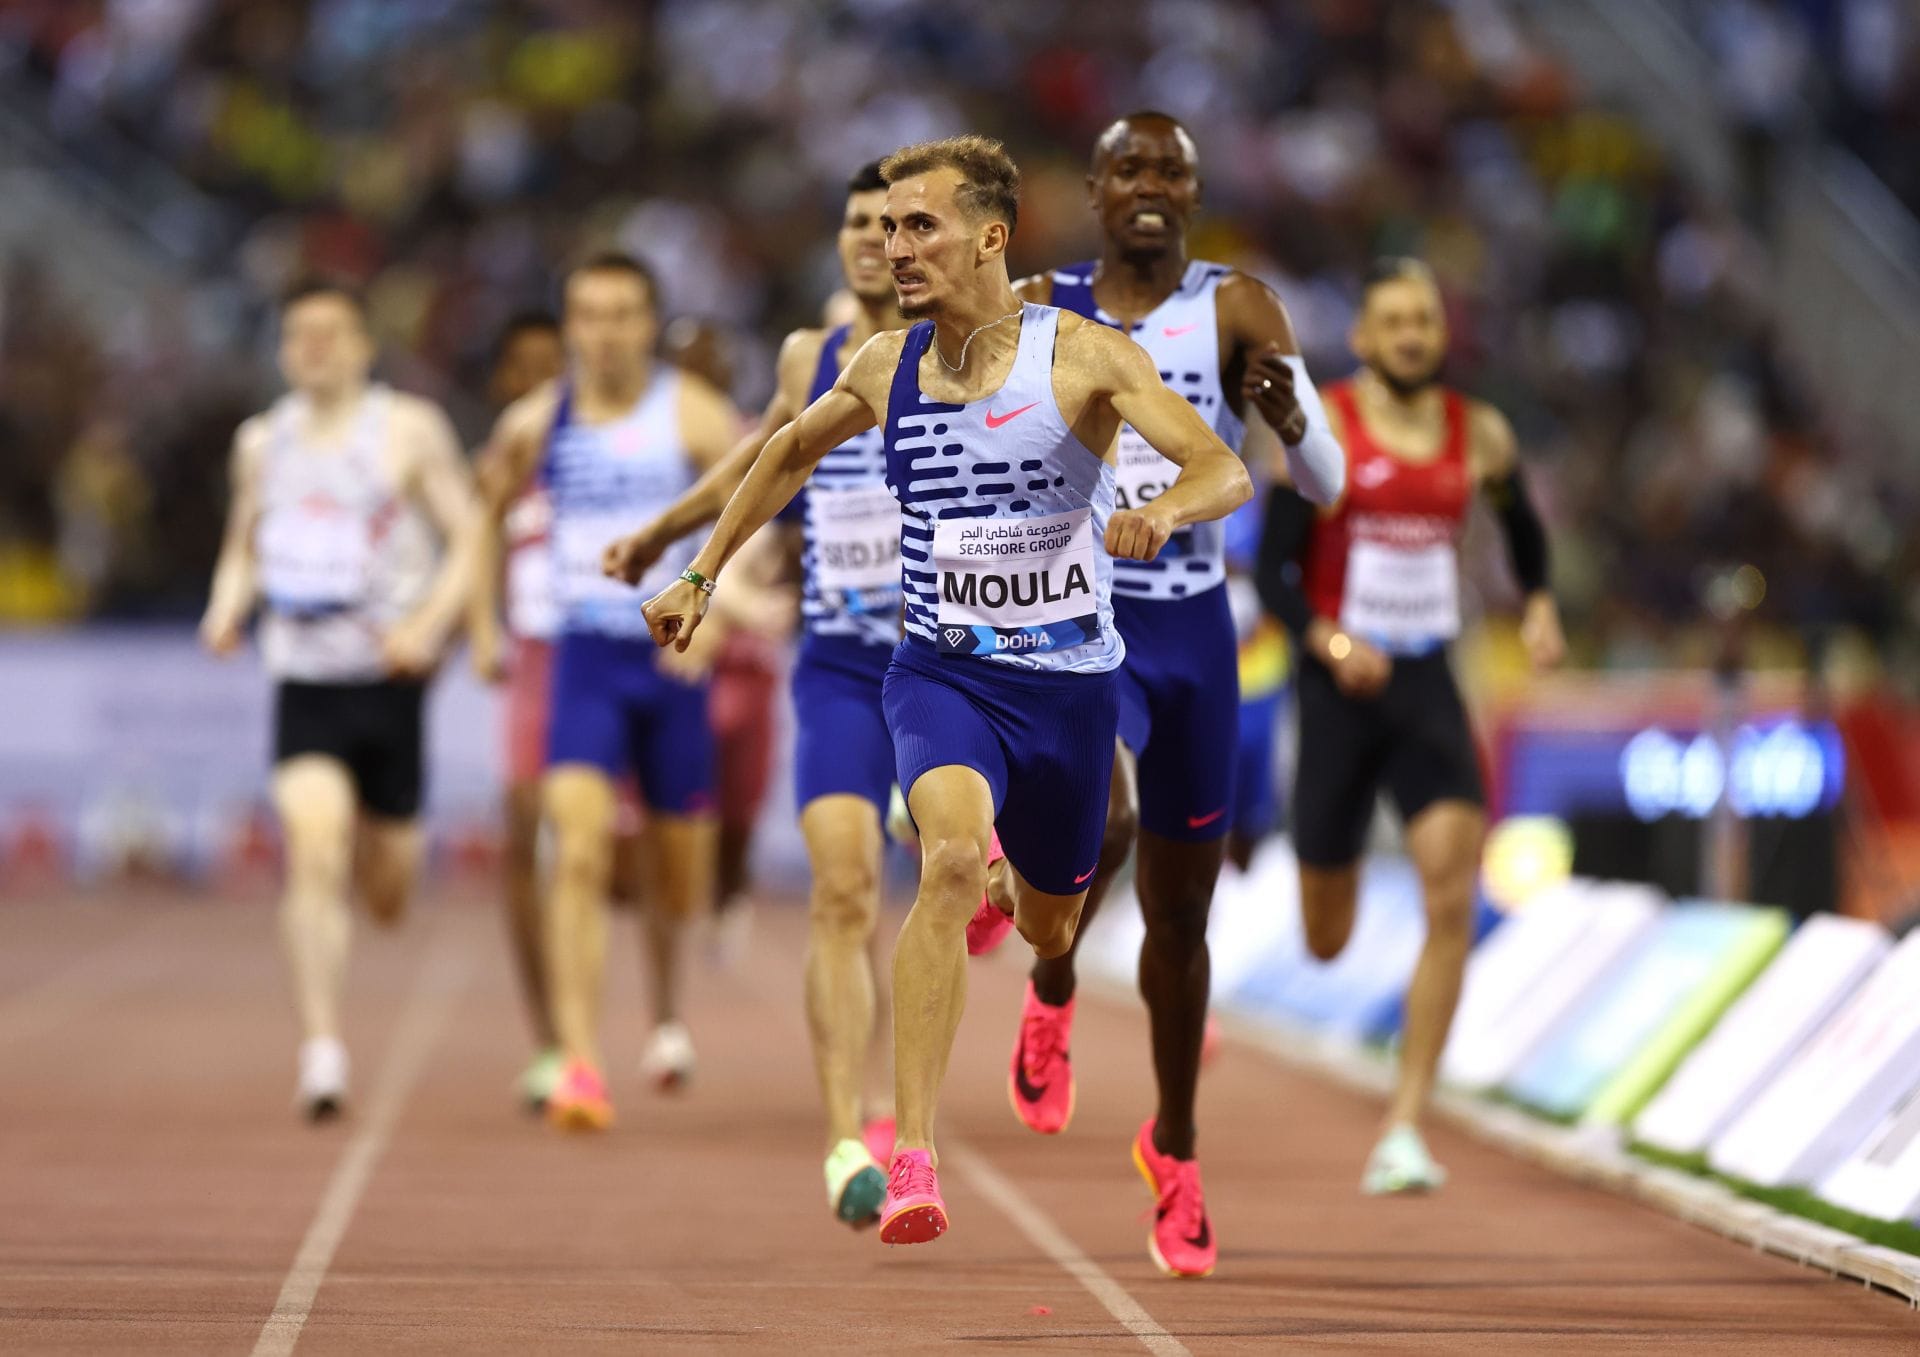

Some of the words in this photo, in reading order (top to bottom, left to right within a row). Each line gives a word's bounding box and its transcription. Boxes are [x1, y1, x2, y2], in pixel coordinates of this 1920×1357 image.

[1115, 484, 1170, 510] AS
[959, 525, 983, 541] البحر
[985, 526, 1023, 541] شاطئ
[1026, 521, 1070, 537] مجموعة
[959, 542, 1026, 556] SEASHORE
[1029, 535, 1072, 552] GROUP
[943, 563, 1091, 609] MOULA
[995, 632, 1051, 650] DOHA
